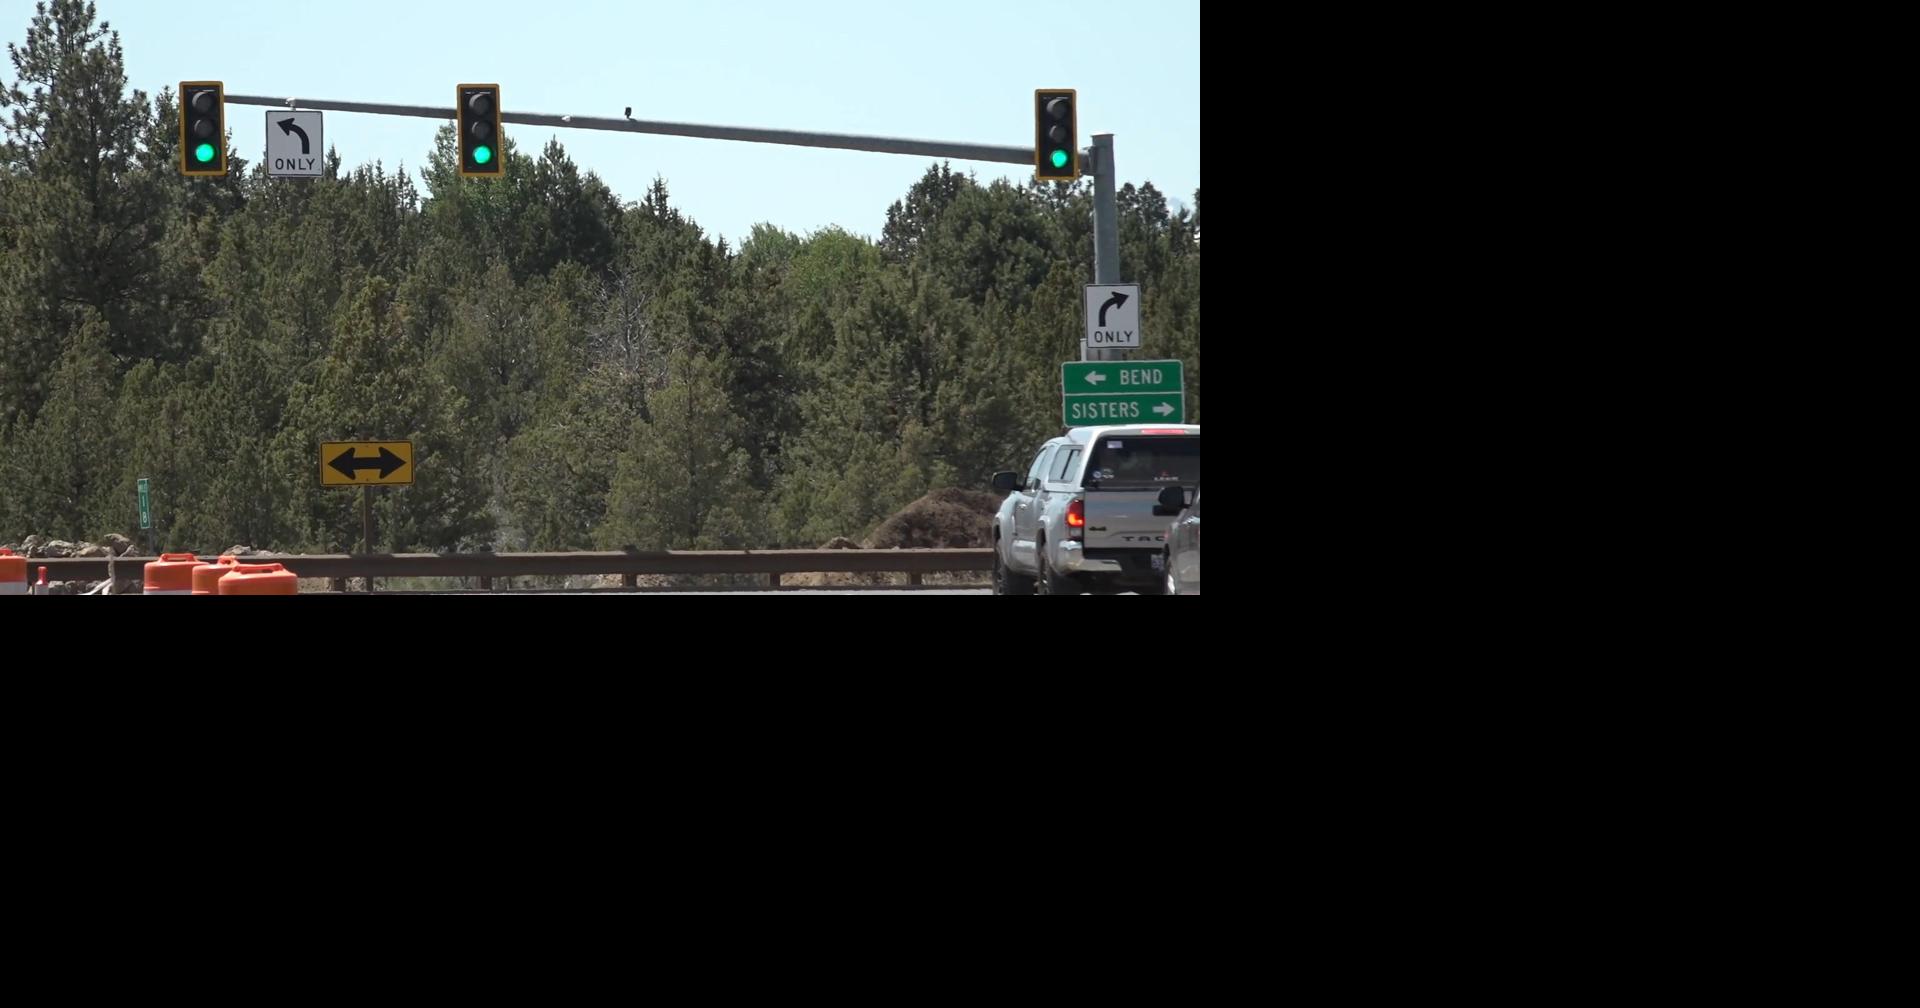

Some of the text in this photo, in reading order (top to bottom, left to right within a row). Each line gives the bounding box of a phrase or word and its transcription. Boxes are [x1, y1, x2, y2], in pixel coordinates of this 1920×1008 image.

[275, 158, 315, 170] ONLY
[1094, 331, 1133, 343] ONLY
[1120, 369, 1162, 385] BEND
[1072, 402, 1140, 419] SISTERS
